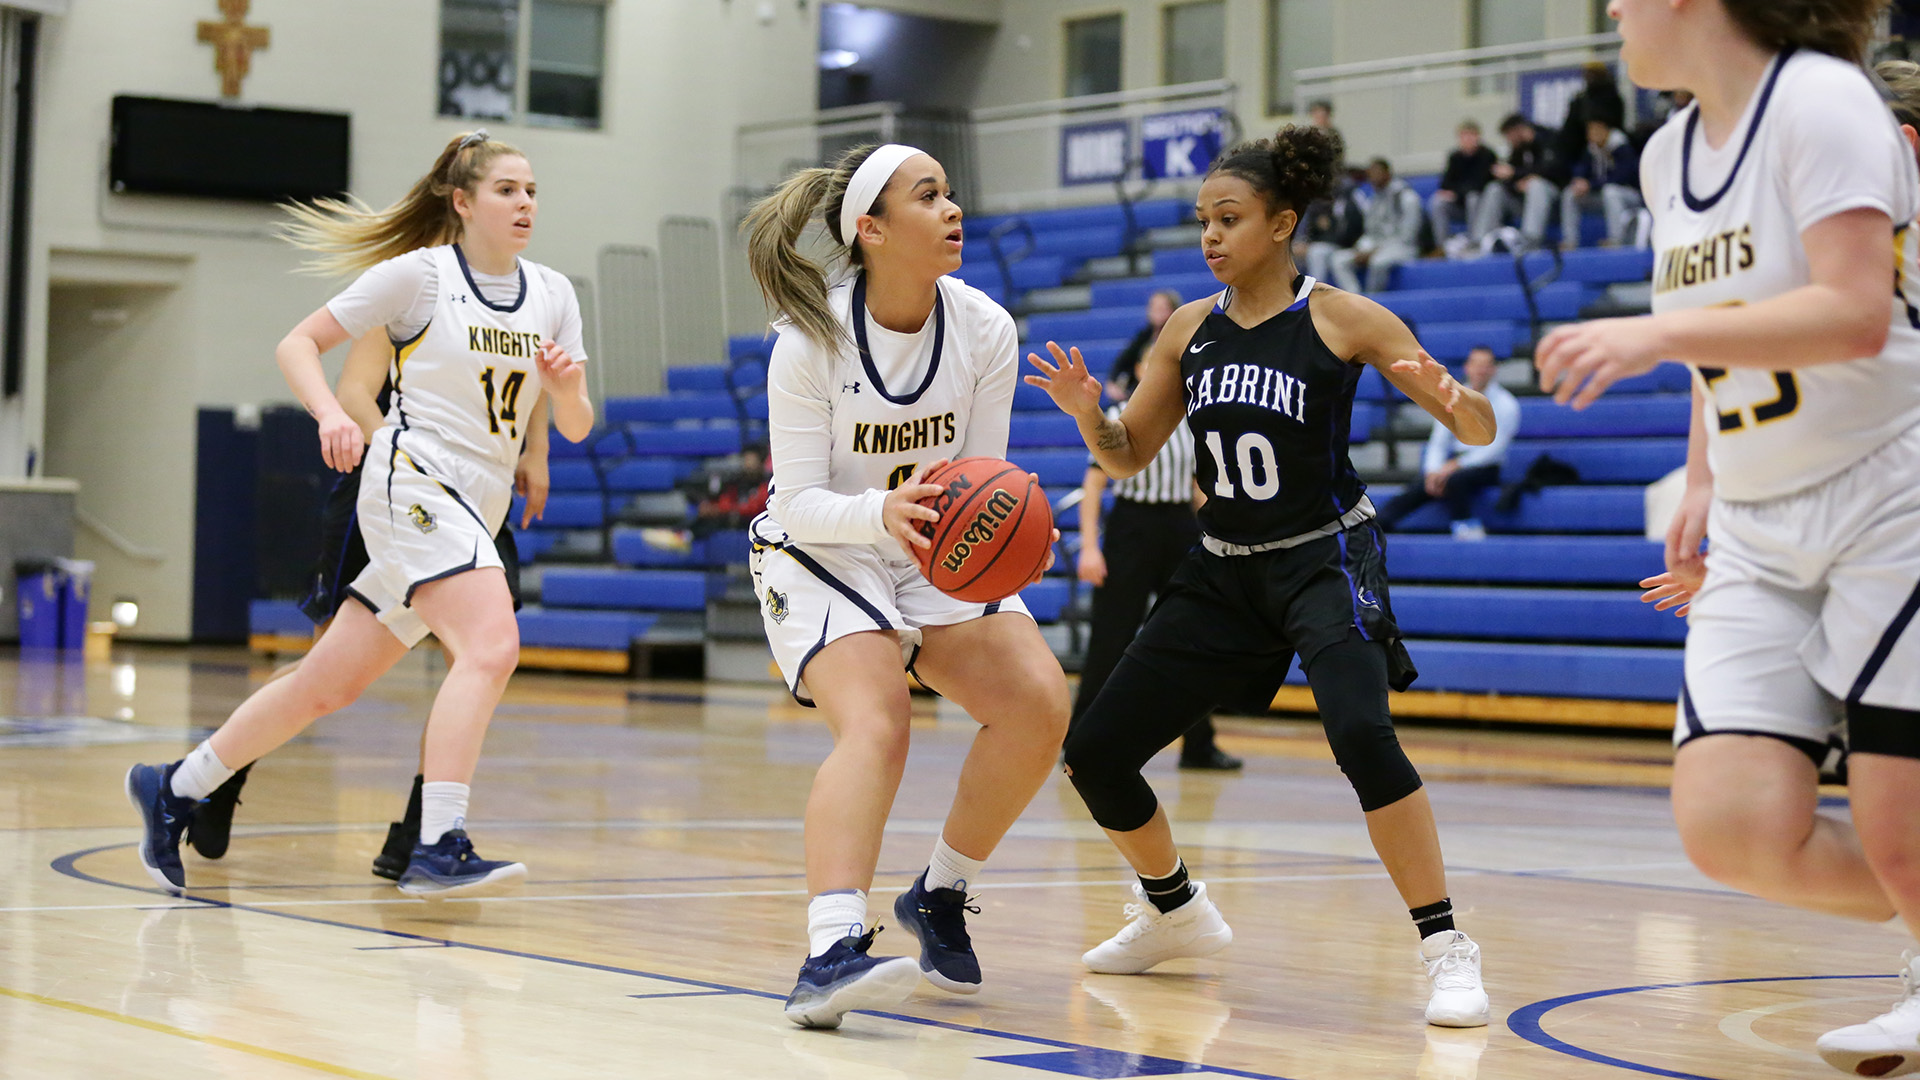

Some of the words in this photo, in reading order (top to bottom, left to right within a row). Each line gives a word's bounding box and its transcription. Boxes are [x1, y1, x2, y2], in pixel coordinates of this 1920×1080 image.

[1165, 136, 1197, 177] K
[1656, 223, 1755, 294] IGHTS
[468, 325, 541, 358] KNIGHTS
[480, 366, 527, 440] 14
[1185, 363, 1307, 424] CABRINI
[853, 411, 956, 455] KNIGHTS
[1204, 431, 1280, 501] 10
[941, 488, 1020, 573] Wilson
